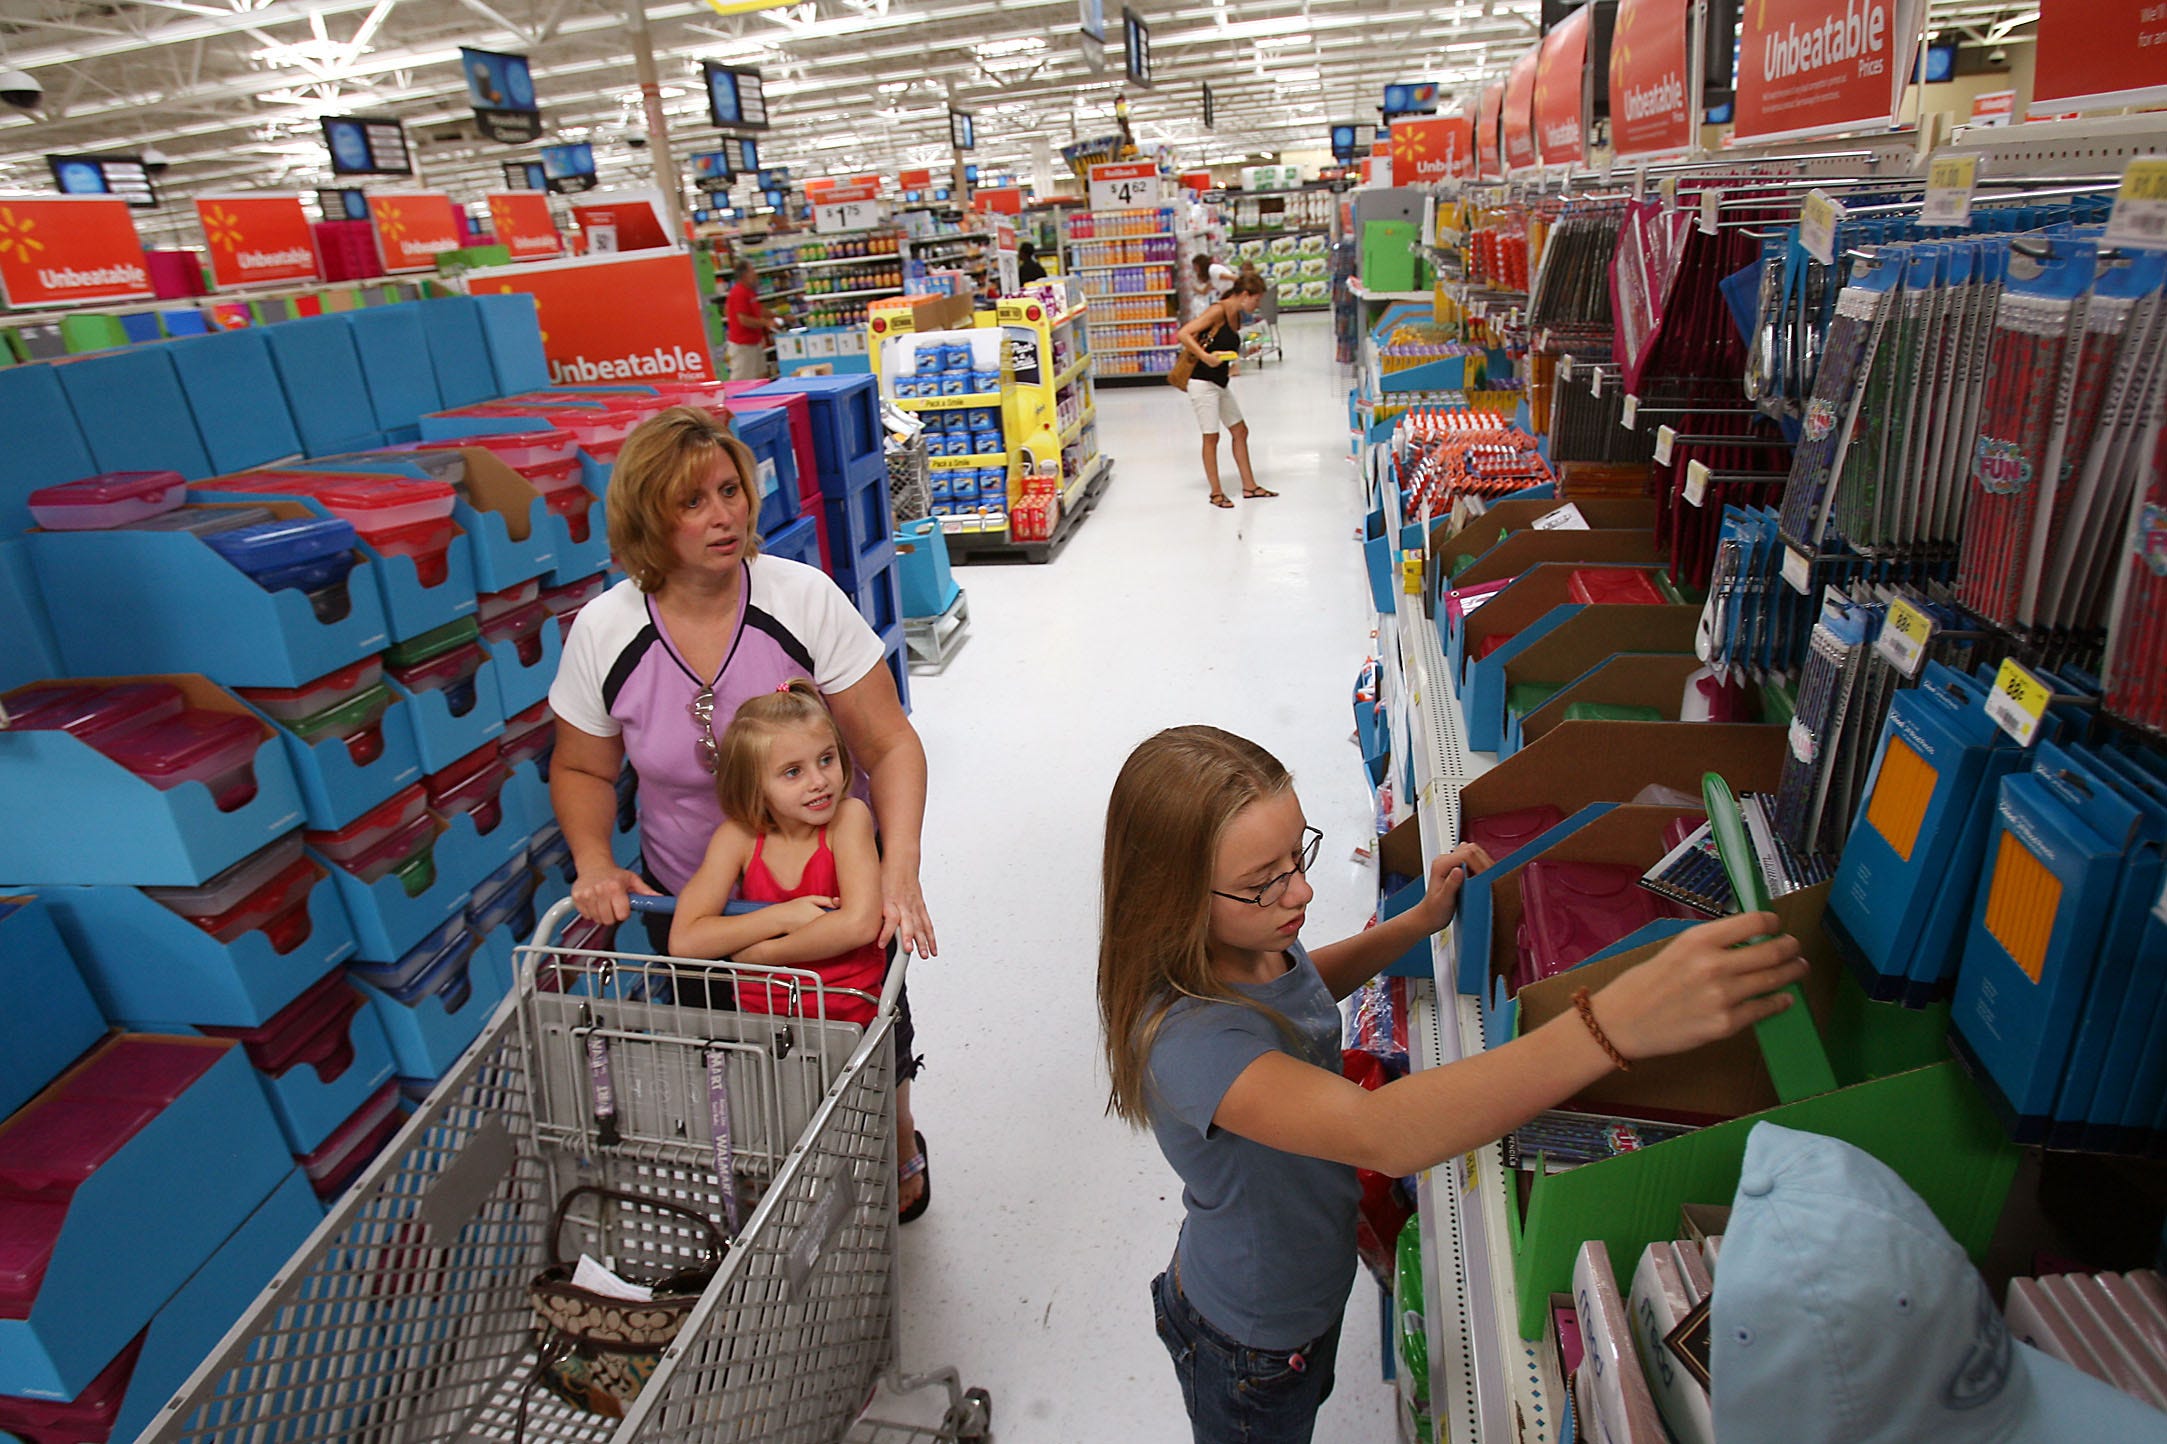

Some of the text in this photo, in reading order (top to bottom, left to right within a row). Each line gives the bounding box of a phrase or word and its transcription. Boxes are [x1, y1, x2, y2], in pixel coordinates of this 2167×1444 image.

[1763, 0, 1885, 82] Unbeatable
[1857, 57, 1884, 78] Prices
[1624, 72, 1683, 121] Unbeatable
[38, 263, 145, 289] Unbeatable
[236, 247, 312, 270] Unbeatable
[550, 346, 702, 384] Unbeatable
[678, 370, 706, 381] Prices
[1980, 456, 2021, 480] FUN
[714, 1133, 734, 1199] WALMART
[1579, 1288, 1604, 1378] mead
[1639, 1296, 1675, 1389] mead
